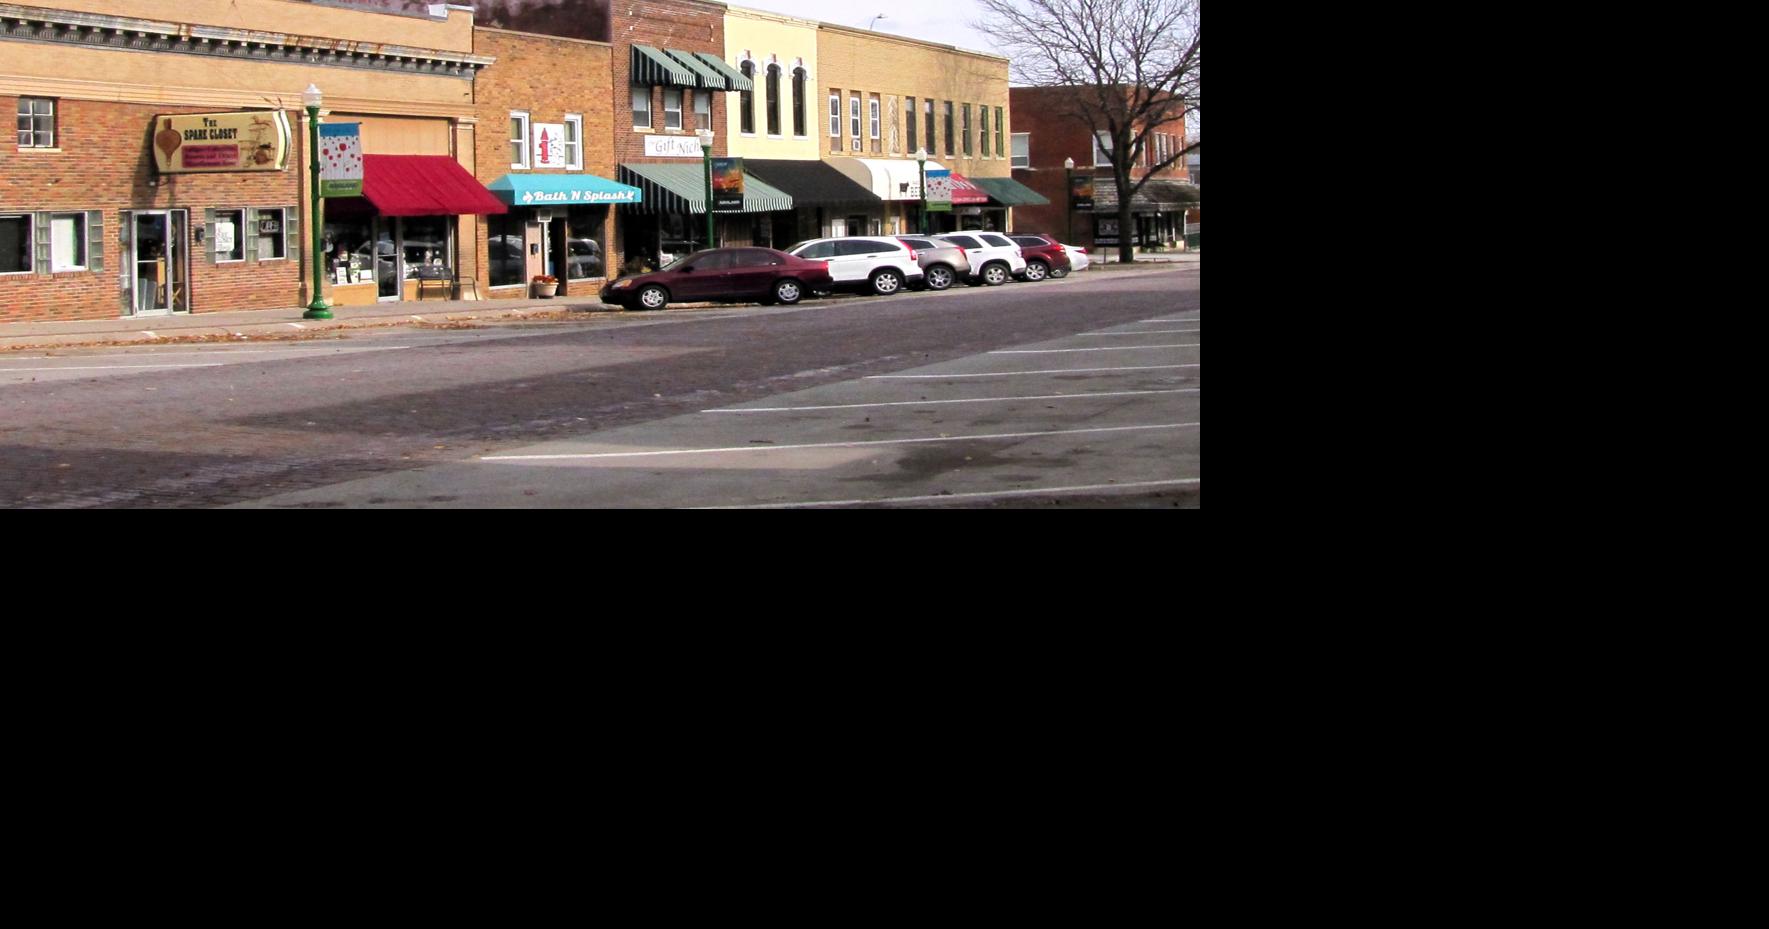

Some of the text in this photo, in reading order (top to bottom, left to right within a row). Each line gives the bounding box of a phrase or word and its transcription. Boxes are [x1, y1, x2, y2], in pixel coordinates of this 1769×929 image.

[184, 128, 238, 141] SPARE CLOSET
[655, 137, 674, 153] Gift
[533, 191, 567, 201] Bath
[583, 190, 625, 203] Splash
